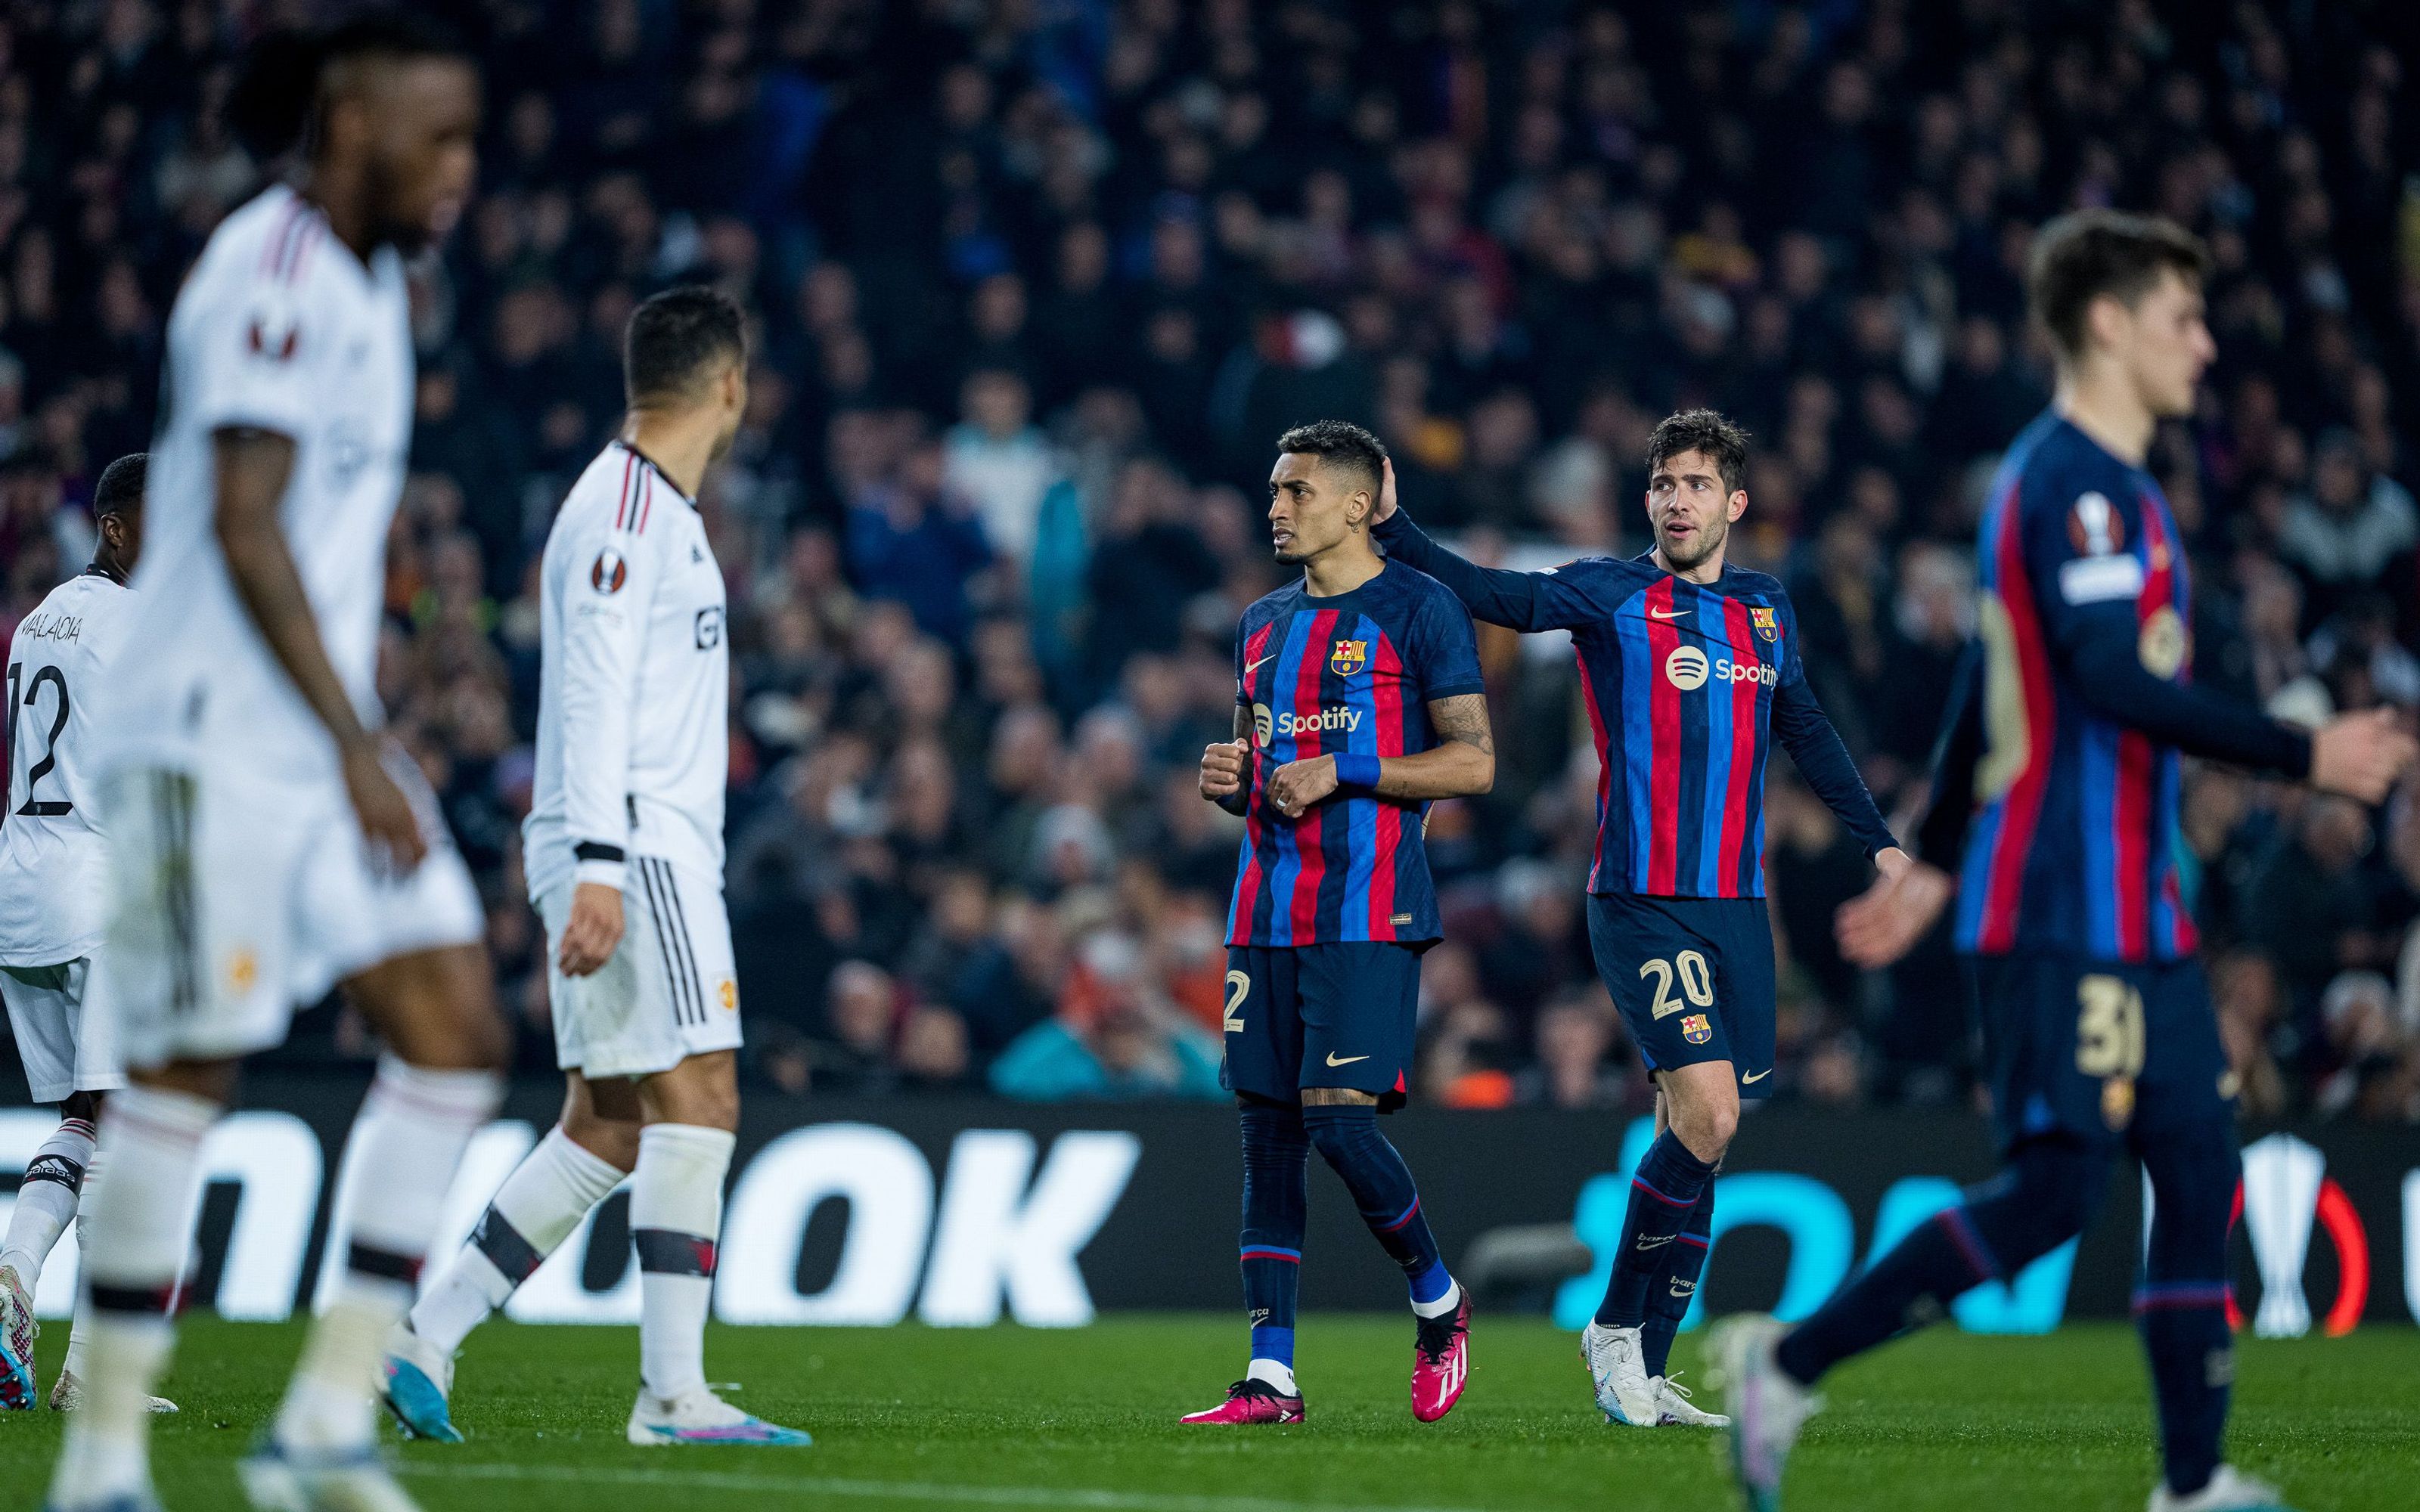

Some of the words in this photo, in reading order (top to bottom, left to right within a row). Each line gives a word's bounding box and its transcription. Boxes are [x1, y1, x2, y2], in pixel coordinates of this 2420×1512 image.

[7, 662, 74, 816] 12
[1277, 706, 1363, 737] Spotify
[1639, 950, 1714, 1021] 20
